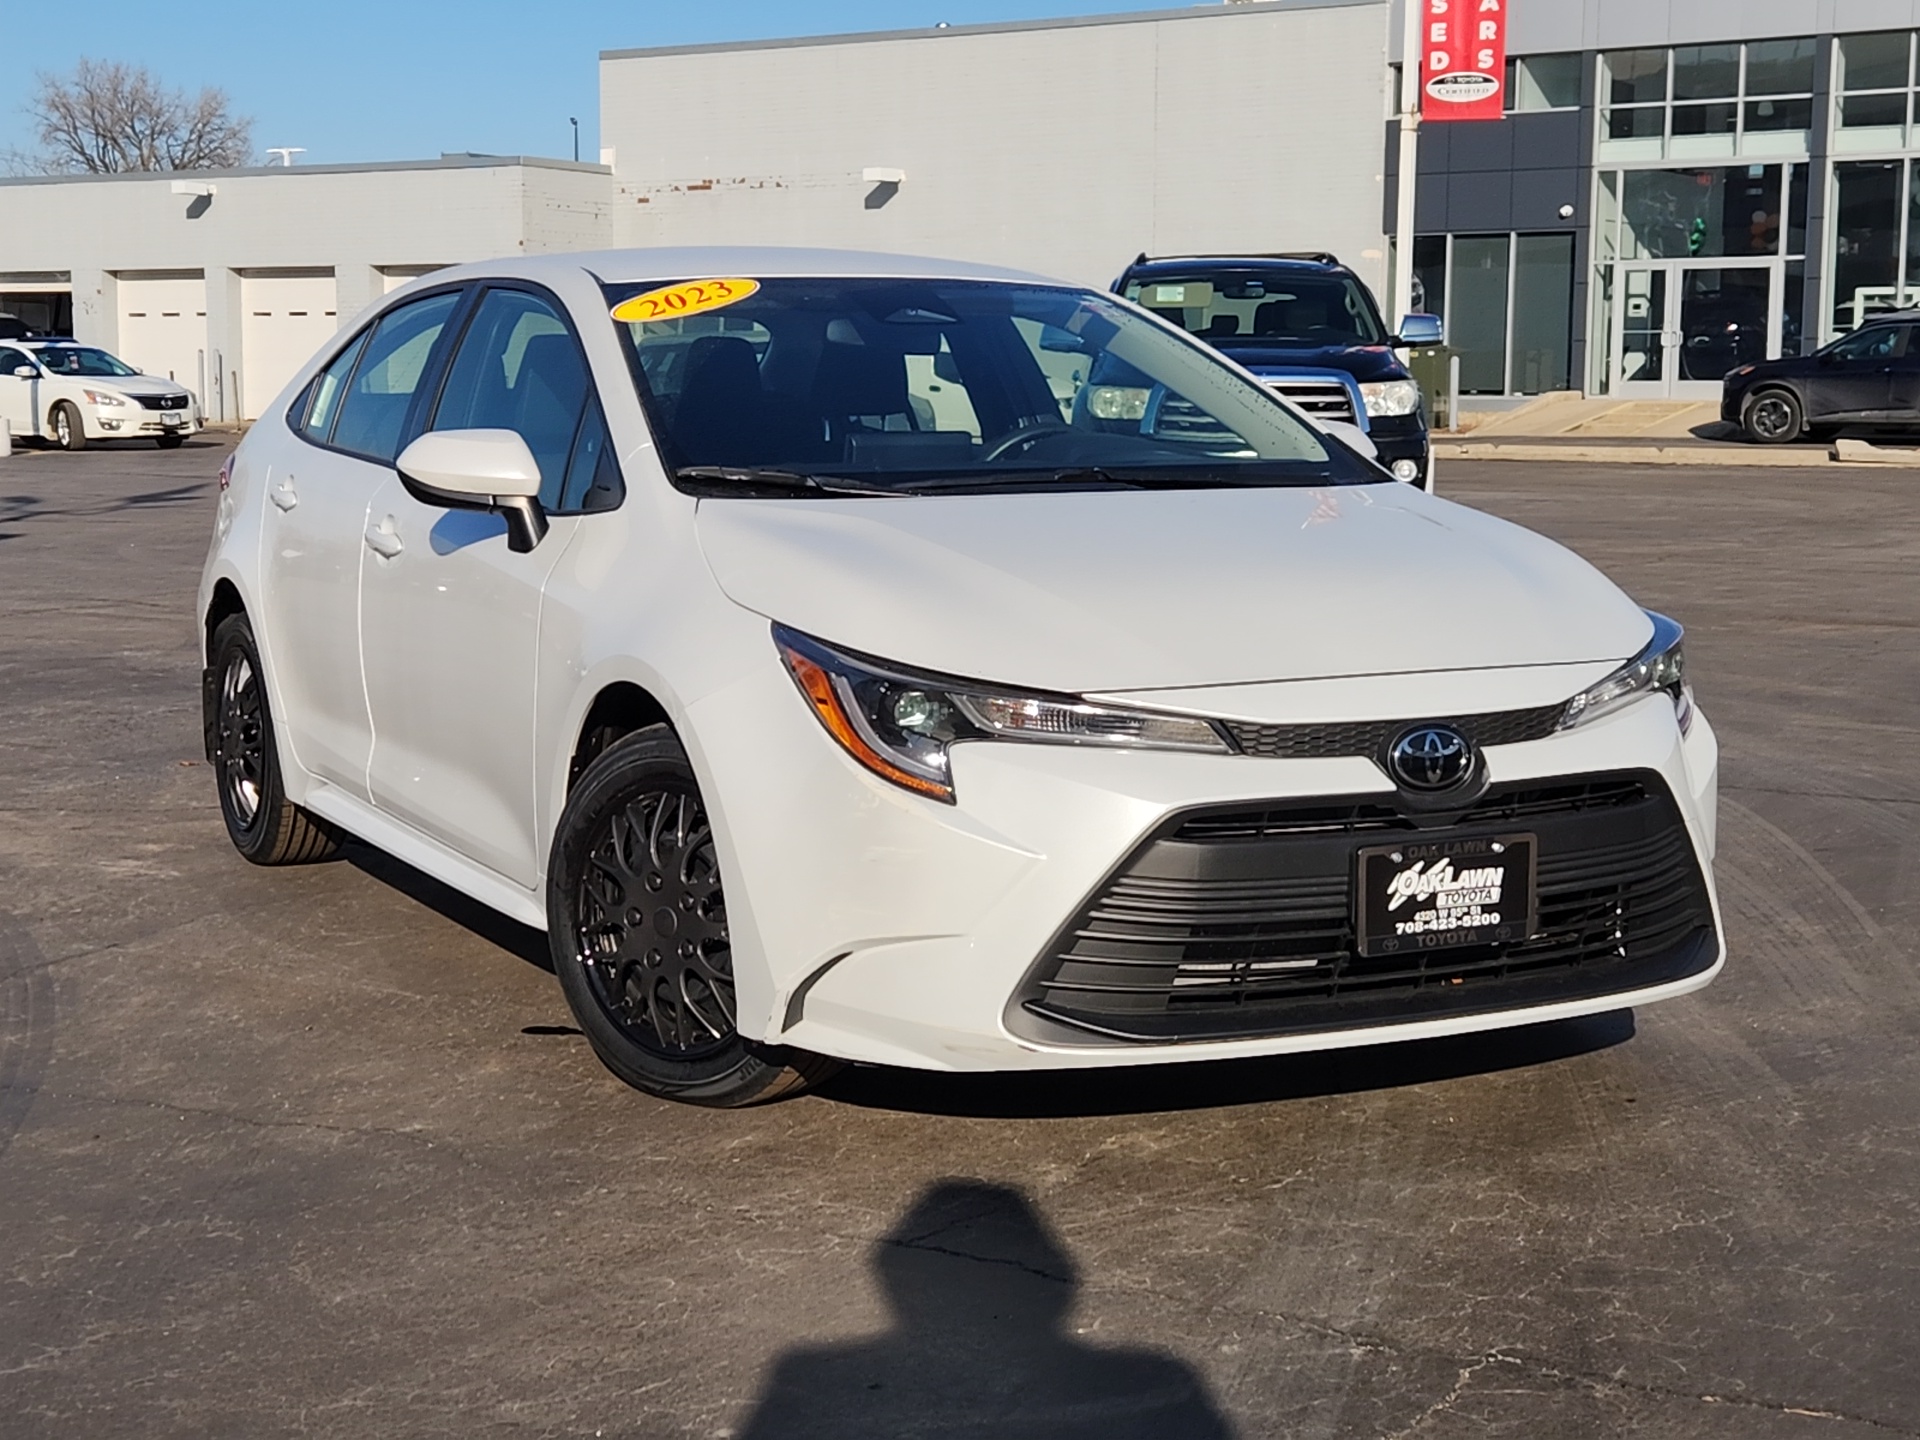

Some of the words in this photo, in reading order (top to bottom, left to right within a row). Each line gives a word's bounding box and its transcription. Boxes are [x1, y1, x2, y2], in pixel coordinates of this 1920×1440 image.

[640, 281, 733, 317] 2023
[1408, 844, 1440, 858] OAK
[1443, 840, 1487, 855] LAWN
[1445, 889, 1493, 904] TOYOTA
[1395, 912, 1501, 935] 708-423-5200
[1416, 930, 1478, 947] TOYOTA
